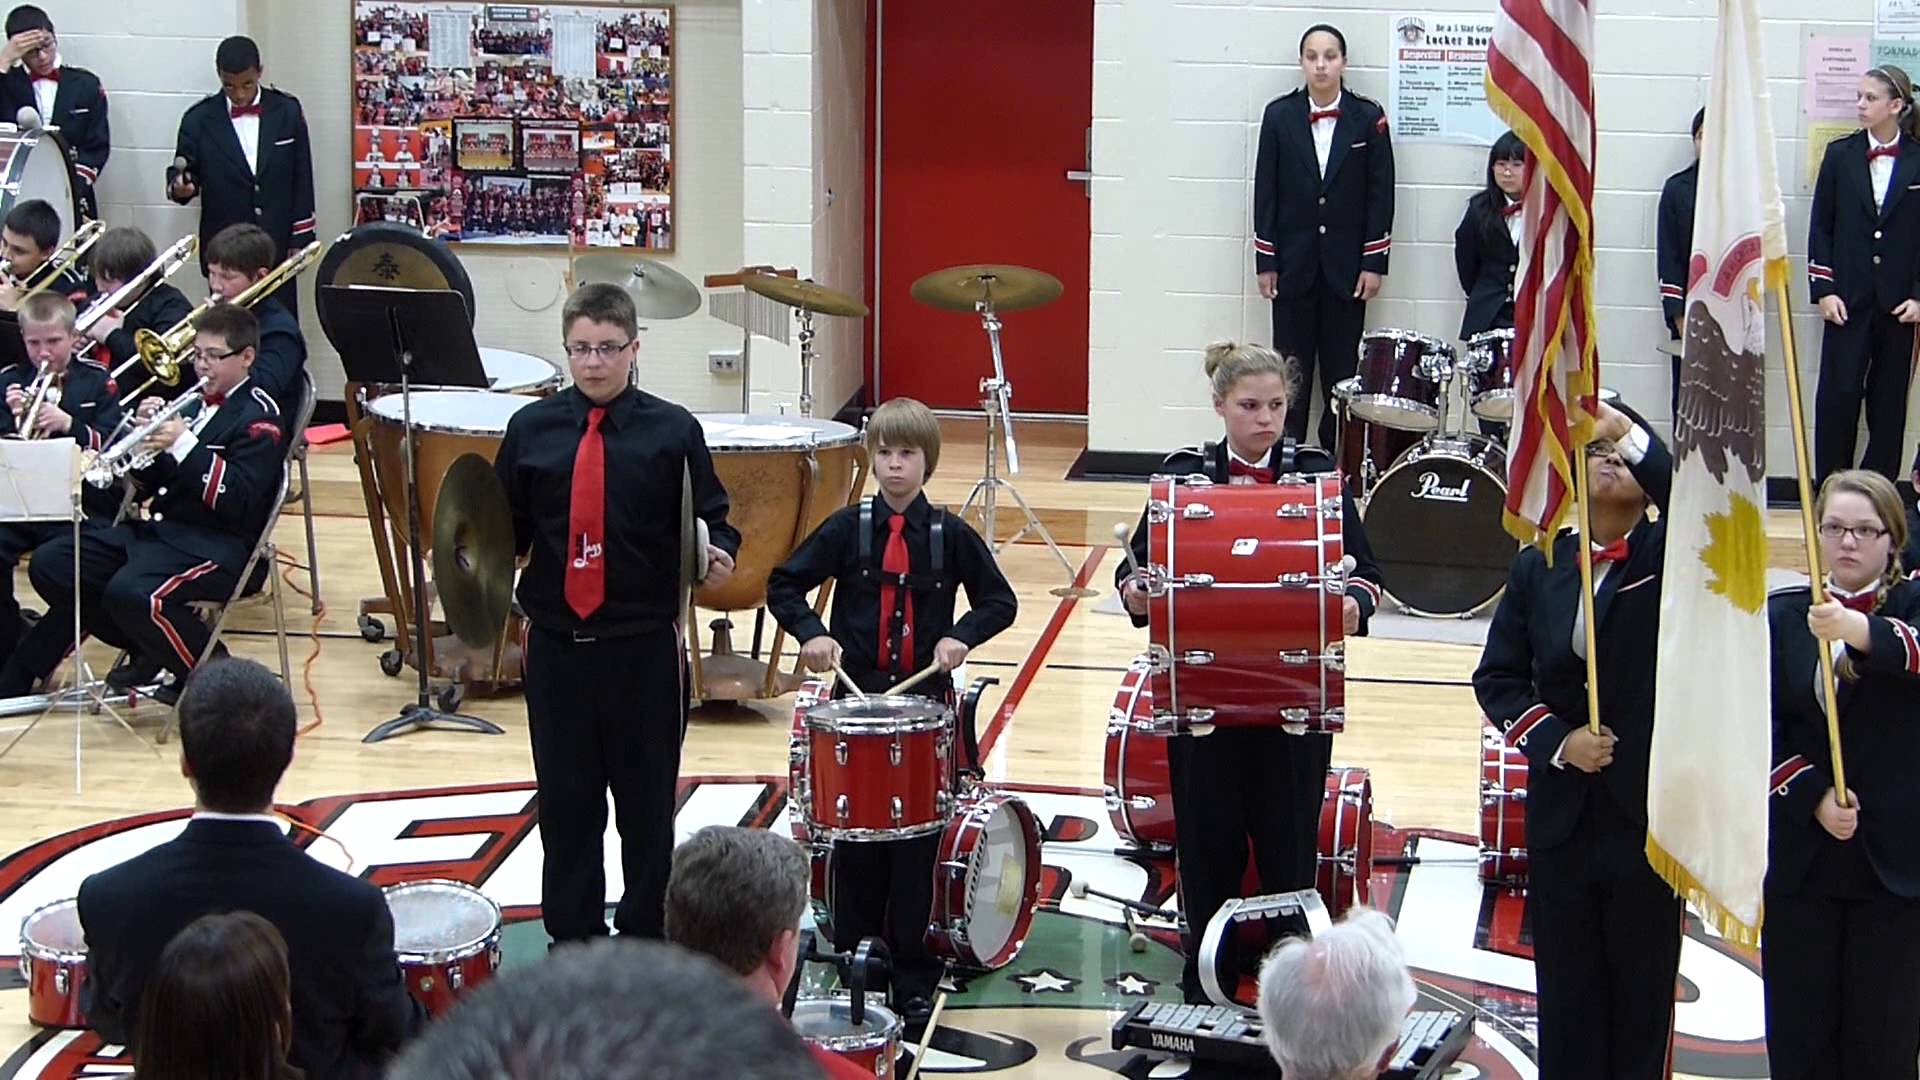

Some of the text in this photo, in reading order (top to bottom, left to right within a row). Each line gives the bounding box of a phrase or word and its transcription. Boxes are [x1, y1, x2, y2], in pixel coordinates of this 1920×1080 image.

[1476, 25, 1493, 33] Gene
[1426, 35, 1487, 46] Locker Roo
[1410, 471, 1471, 499] Pearl
[1151, 1033, 1195, 1052] YAMAHA
